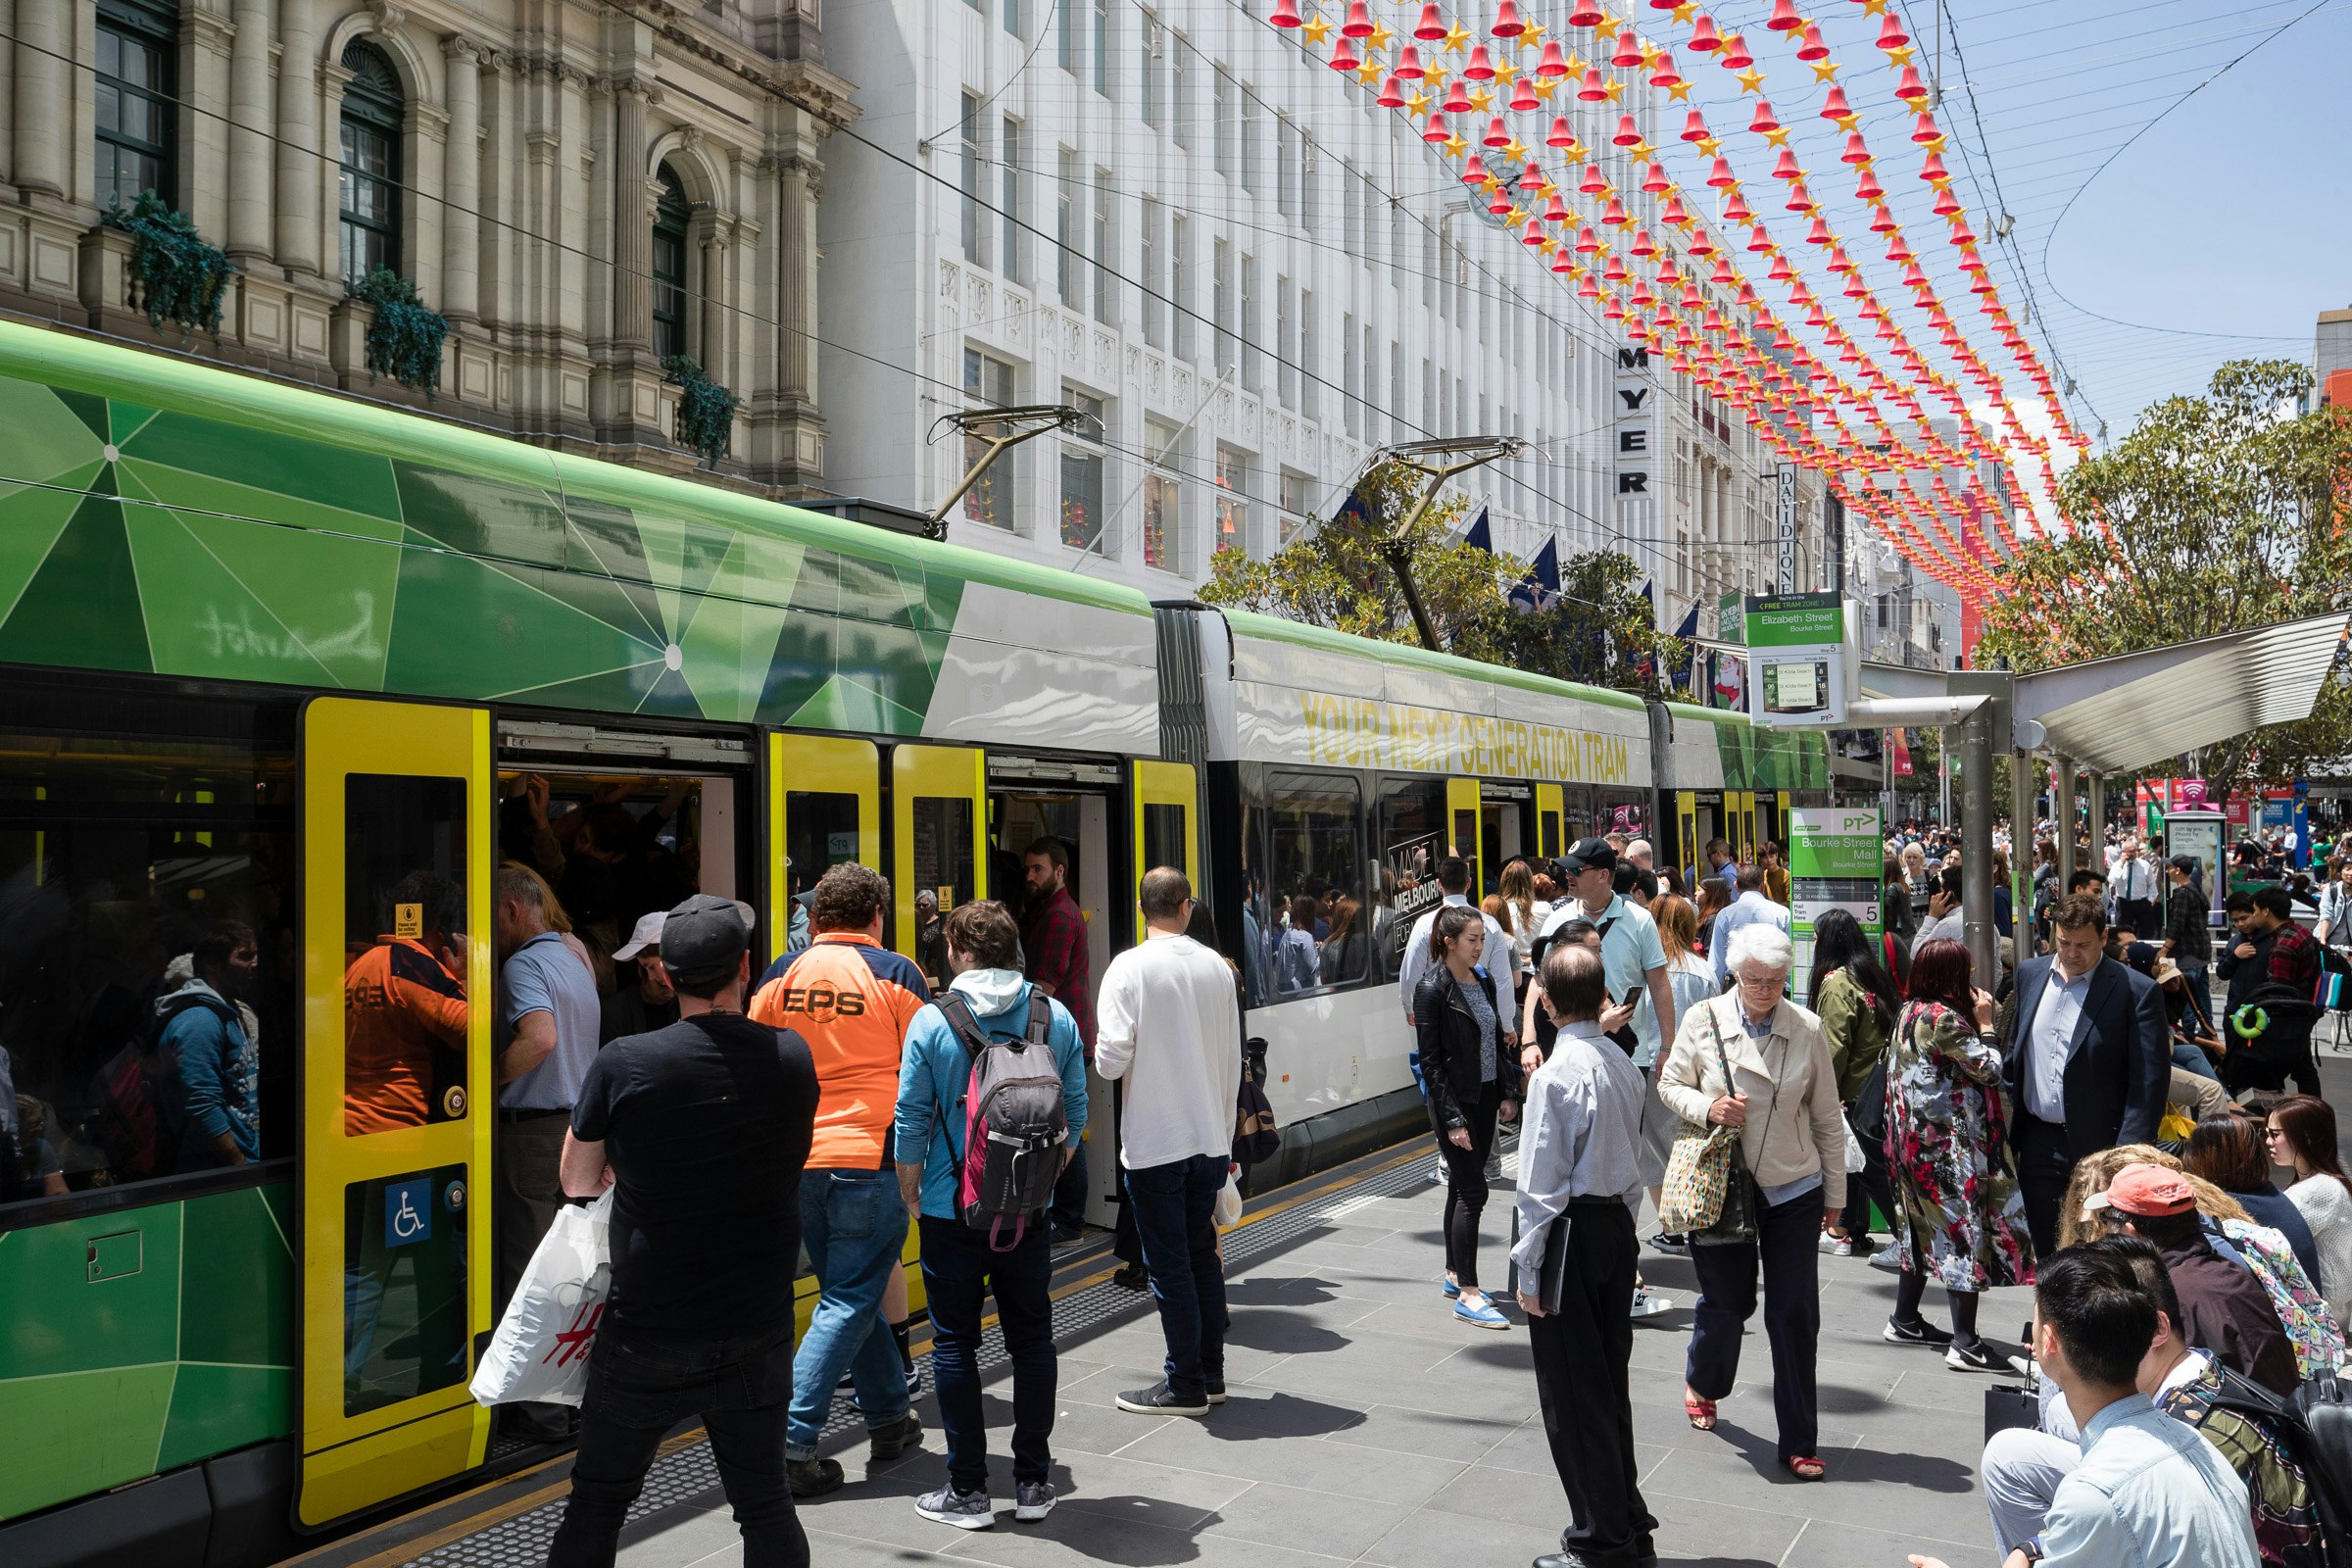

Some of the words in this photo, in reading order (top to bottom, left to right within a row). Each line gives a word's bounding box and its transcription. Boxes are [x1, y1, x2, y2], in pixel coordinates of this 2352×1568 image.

[1618, 346, 1648, 494] MYER
[1781, 472, 1793, 537] DAVID
[1781, 543, 1793, 594] JONE
[1762, 614, 1802, 624] Elizabeth
[1805, 612, 1833, 622] Street
[1301, 693, 1382, 768] YOUR
[1388, 706, 1453, 773] NEXT
[1460, 716, 1582, 781] GENERATION
[1584, 733, 1628, 784] TRAM
[1801, 838, 1839, 848] Bourke
[1843, 837, 1876, 848] Street
[1854, 849, 1877, 859] Mall
[1391, 841, 1432, 890] MADE
[1867, 906, 1877, 921] 5
[1396, 923, 1411, 945] FOR
[783, 989, 864, 1016] EPS
[542, 1301, 606, 1368] H&
